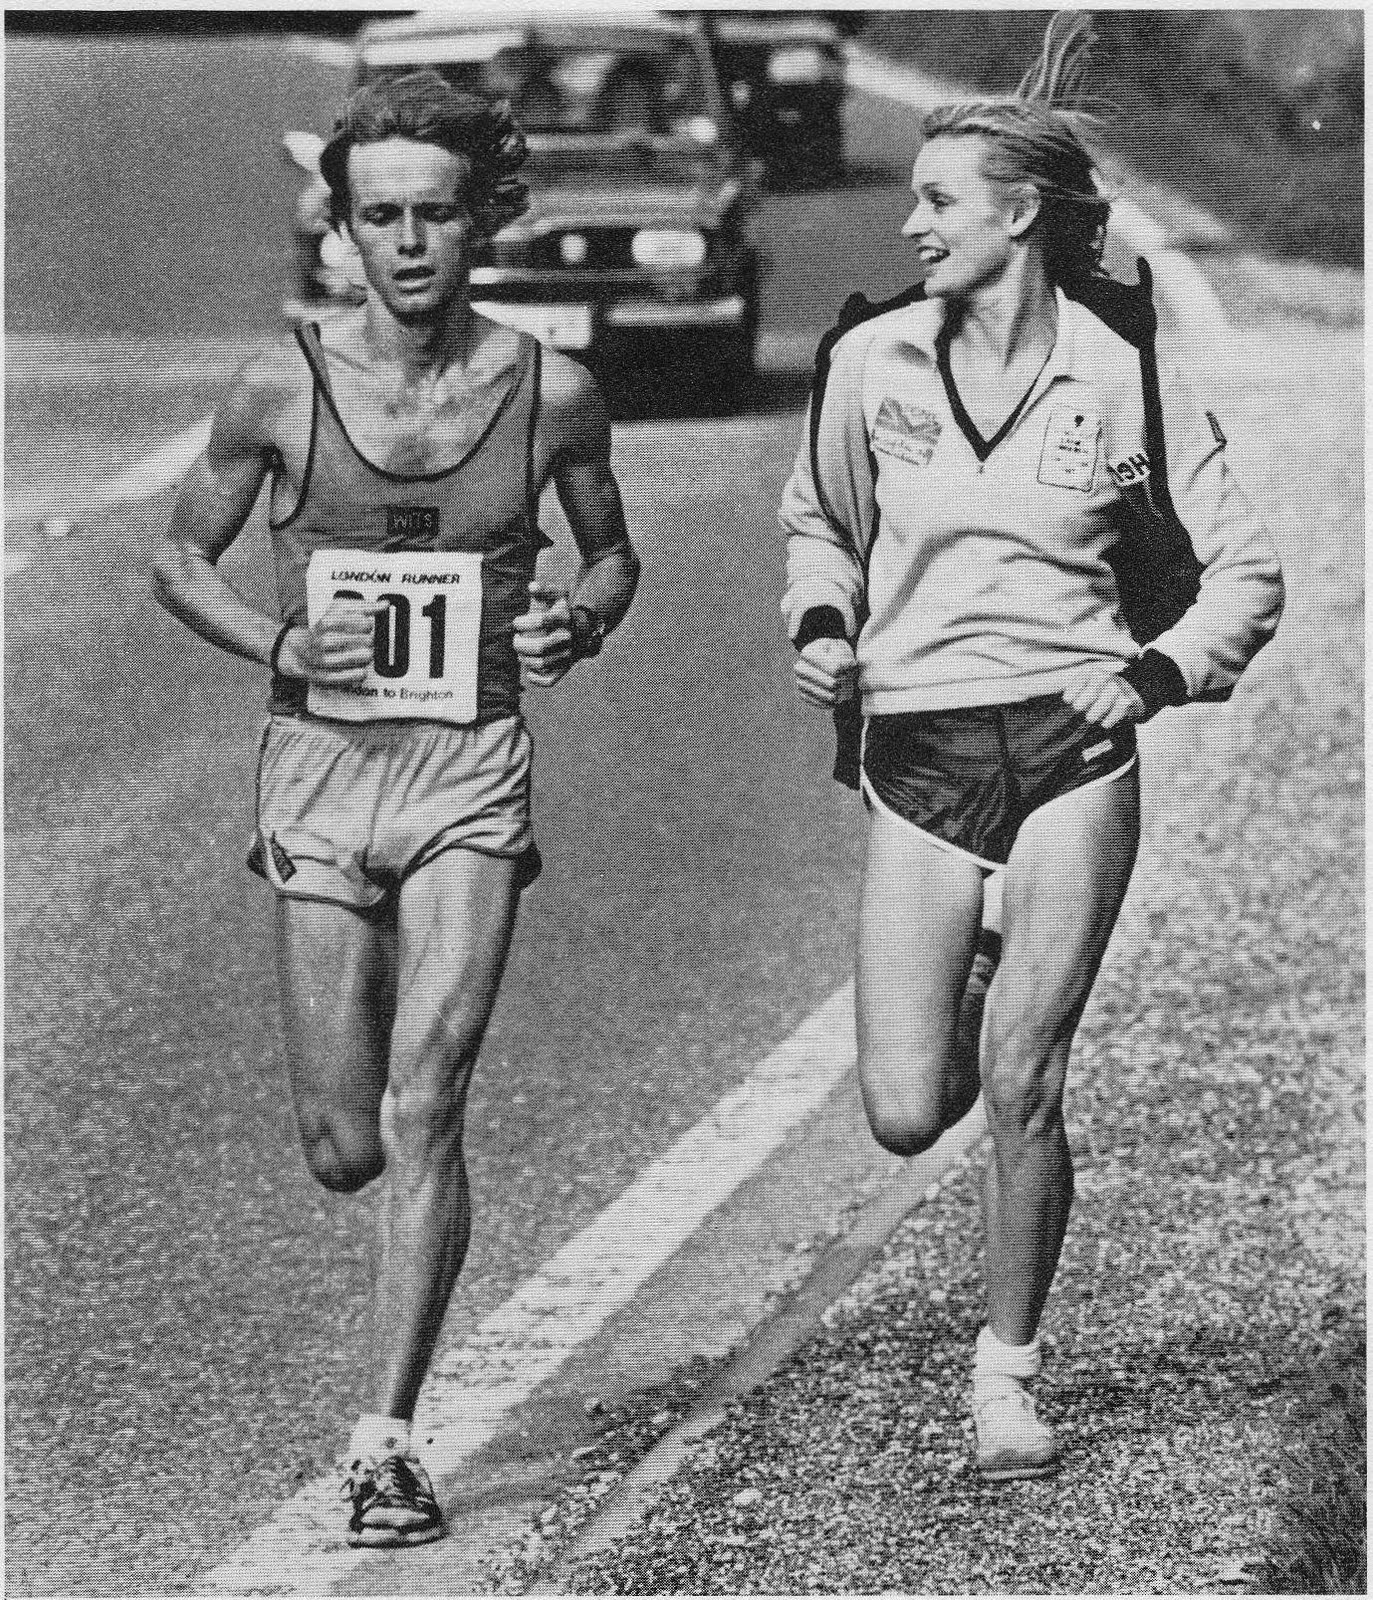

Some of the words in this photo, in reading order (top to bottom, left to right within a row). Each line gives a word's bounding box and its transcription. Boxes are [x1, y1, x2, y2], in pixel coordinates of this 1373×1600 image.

[330, 569, 392, 584] LONDON
[401, 572, 461, 585] RUNNER
[332, 589, 447, 679] 01
[383, 687, 397, 699] to
[400, 687, 454, 703] Brighton
